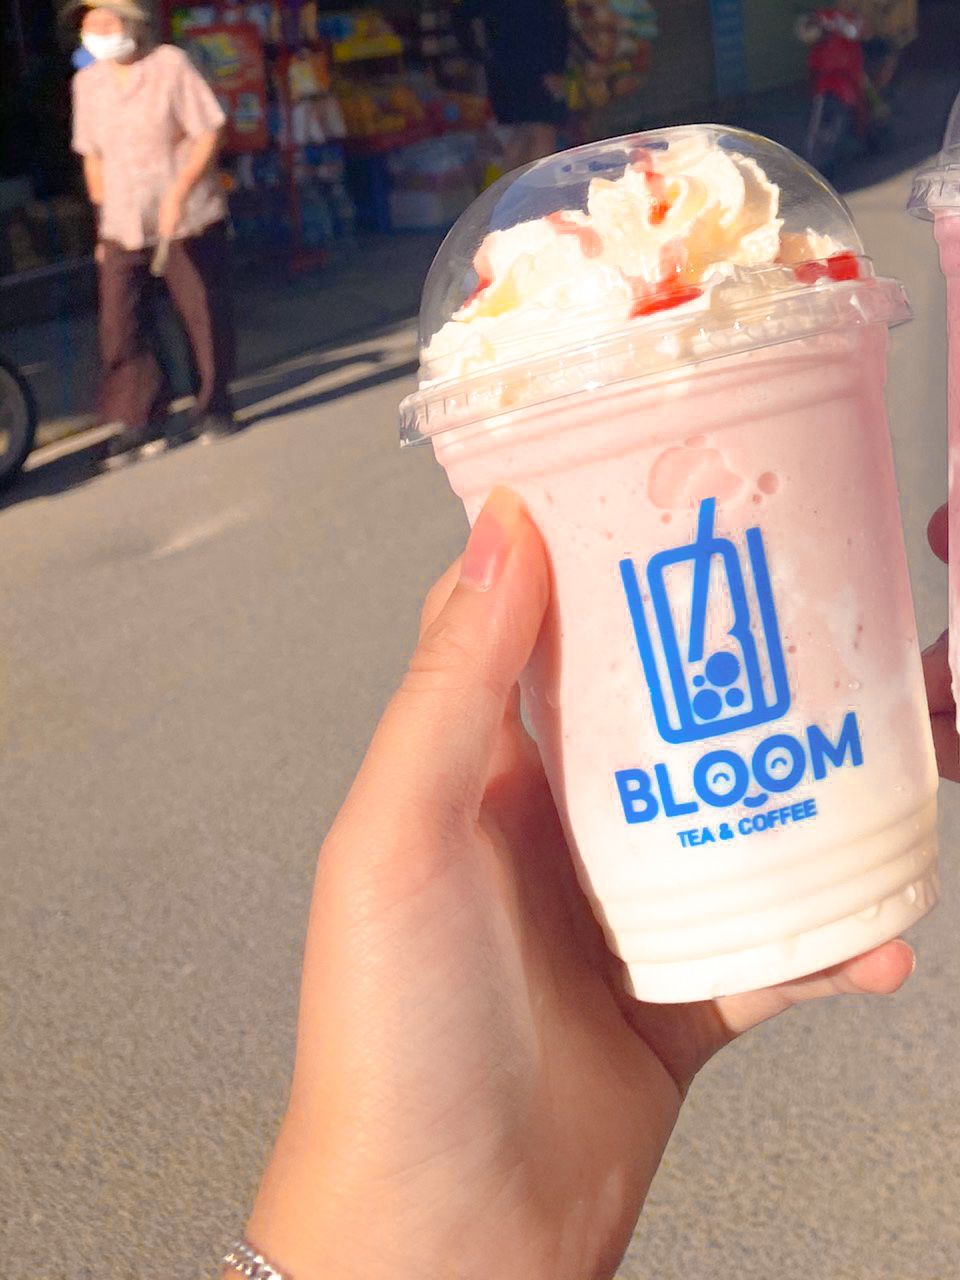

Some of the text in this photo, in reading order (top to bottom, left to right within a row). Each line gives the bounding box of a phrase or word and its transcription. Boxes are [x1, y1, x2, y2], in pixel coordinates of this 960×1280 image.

[614, 711, 864, 825] BLOOM
[676, 798, 818, 848] TEA & COFFEE
